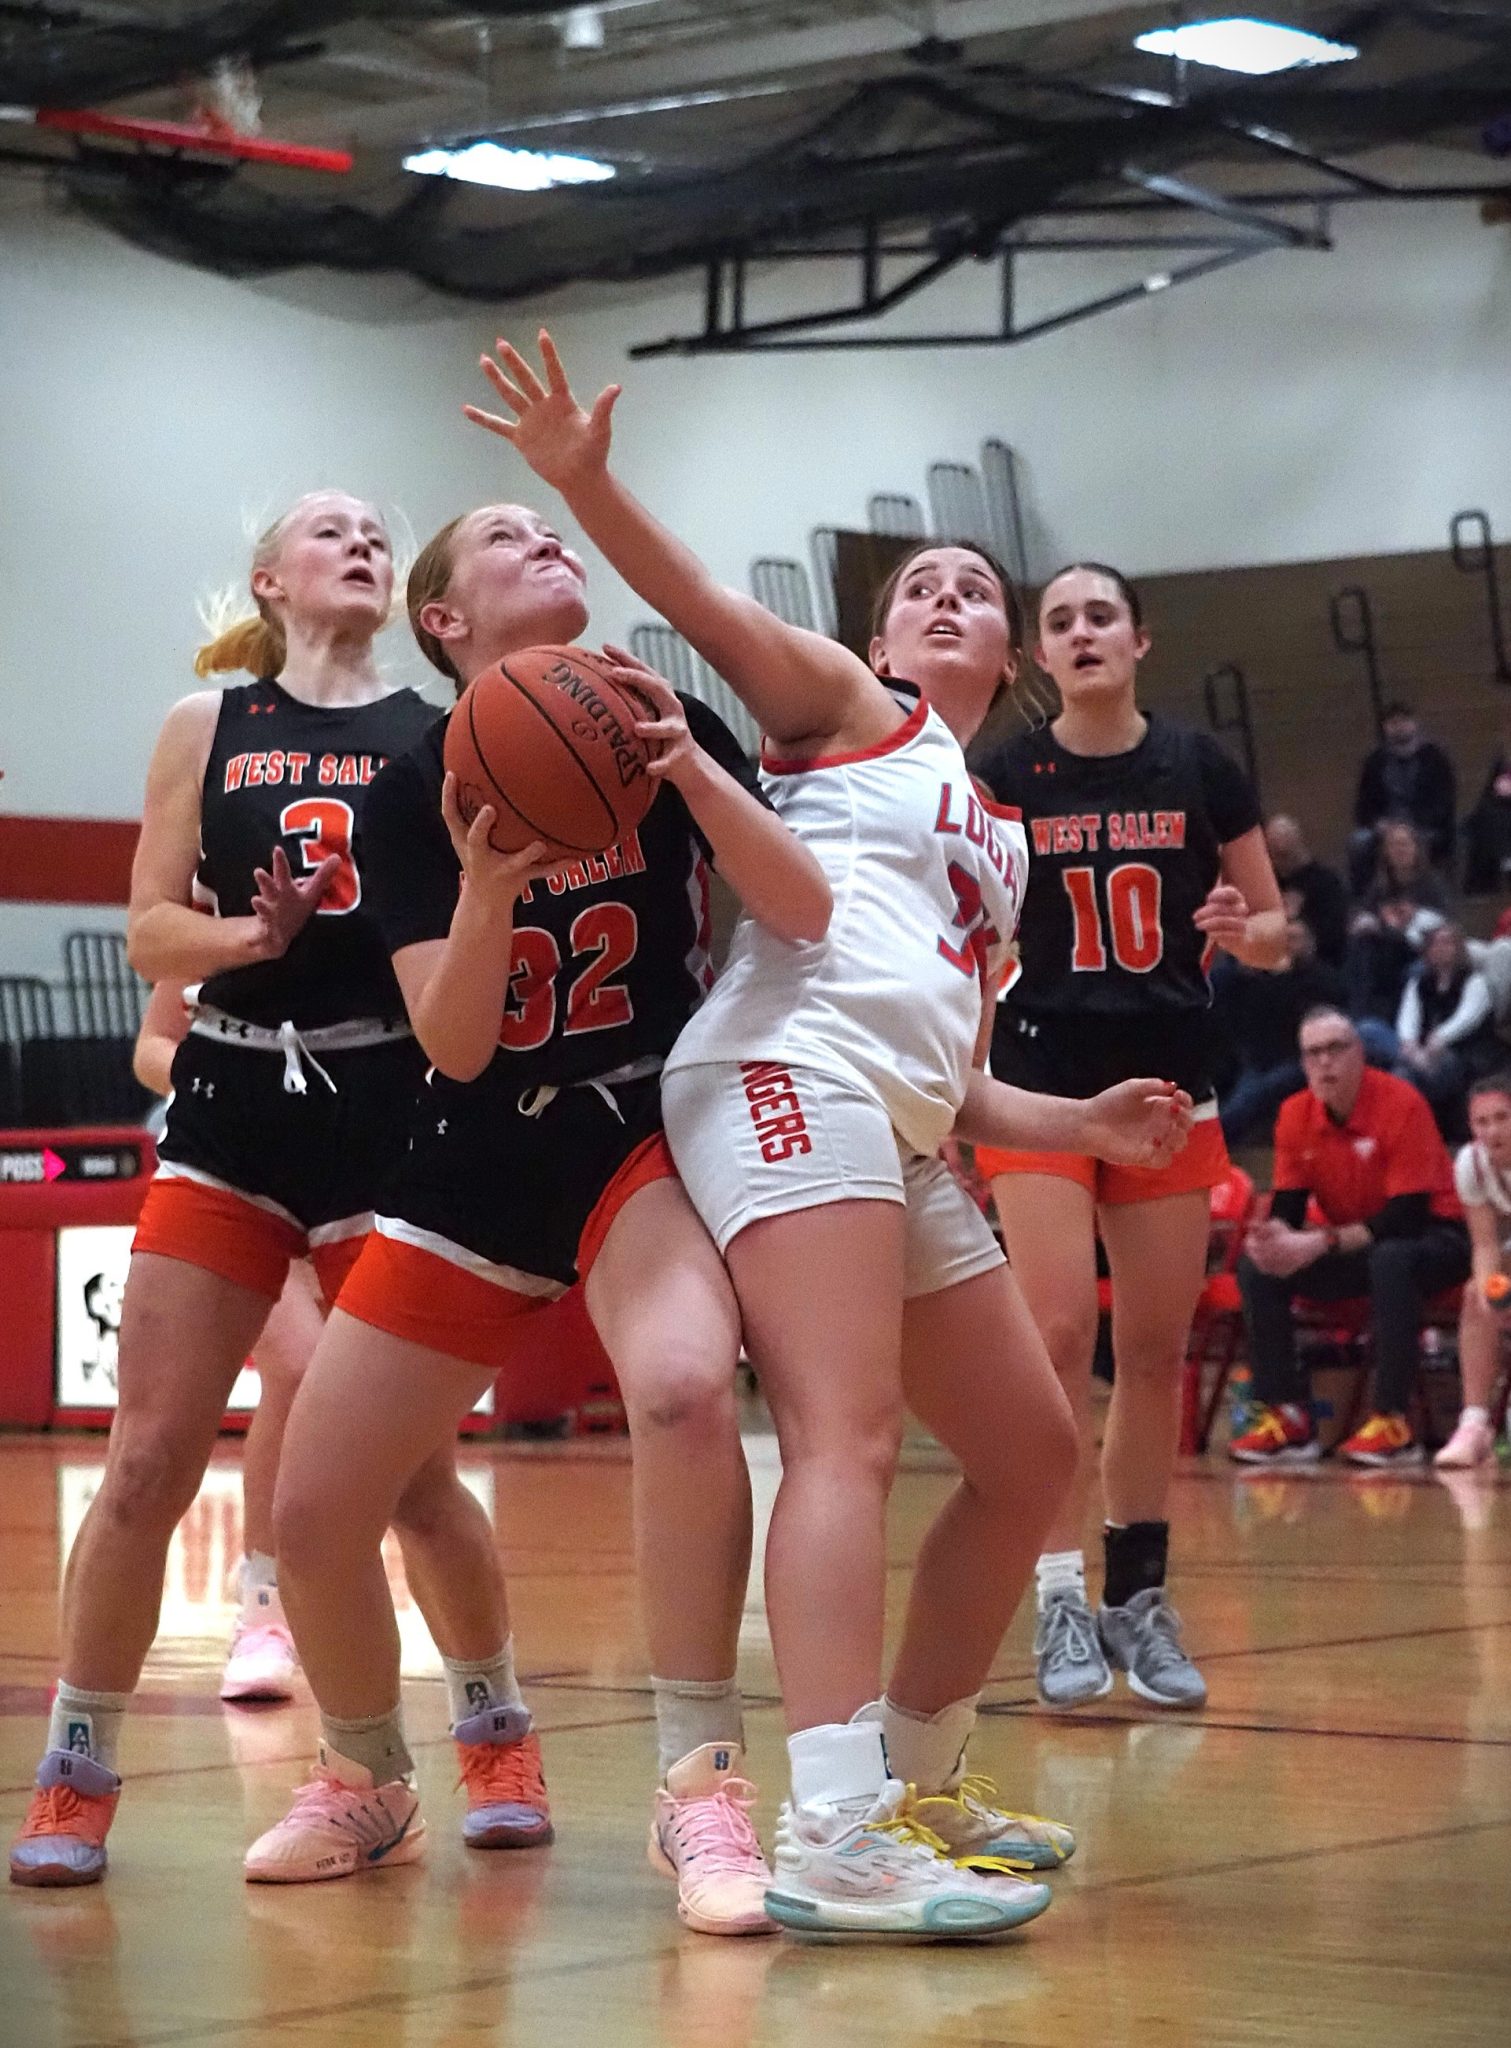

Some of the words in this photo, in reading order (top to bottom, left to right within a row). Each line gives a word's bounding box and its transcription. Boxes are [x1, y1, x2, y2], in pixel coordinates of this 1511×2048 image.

[224, 750, 311, 794] WEST
[318, 753, 391, 786] SAL
[543, 661, 649, 788] SPALDING
[280, 797, 362, 916] 3
[934, 782, 1021, 938] LOGA
[1030, 814, 1102, 856] WEST
[1107, 811, 1186, 851] SALEM
[1062, 862, 1164, 974] 10
[500, 901, 638, 1052] 32
[738, 1062, 813, 1164] NGERS
